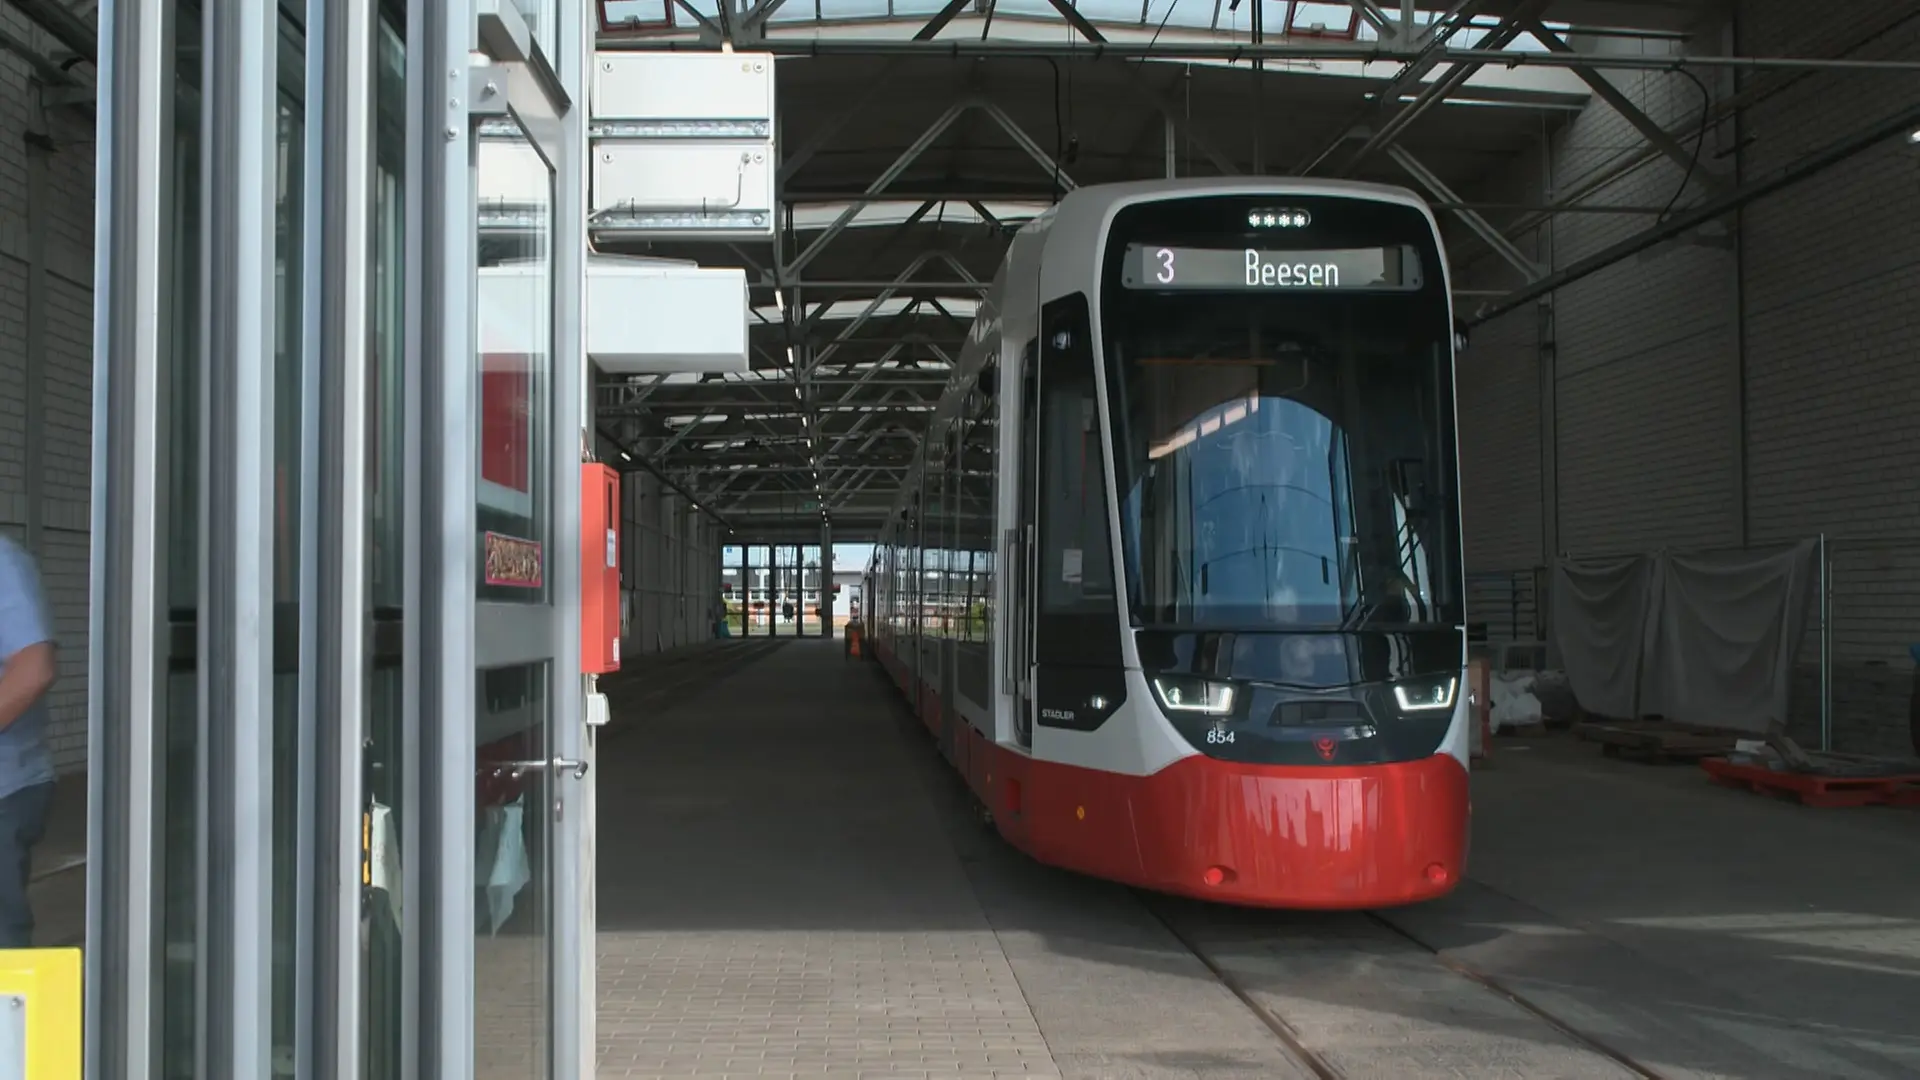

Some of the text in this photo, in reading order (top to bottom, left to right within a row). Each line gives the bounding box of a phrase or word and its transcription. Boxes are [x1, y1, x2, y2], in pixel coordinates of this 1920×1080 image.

[1156, 248, 1339, 288] 3 Beesen
[1041, 708, 1075, 720] STADLER
[1207, 730, 1235, 744] 854
